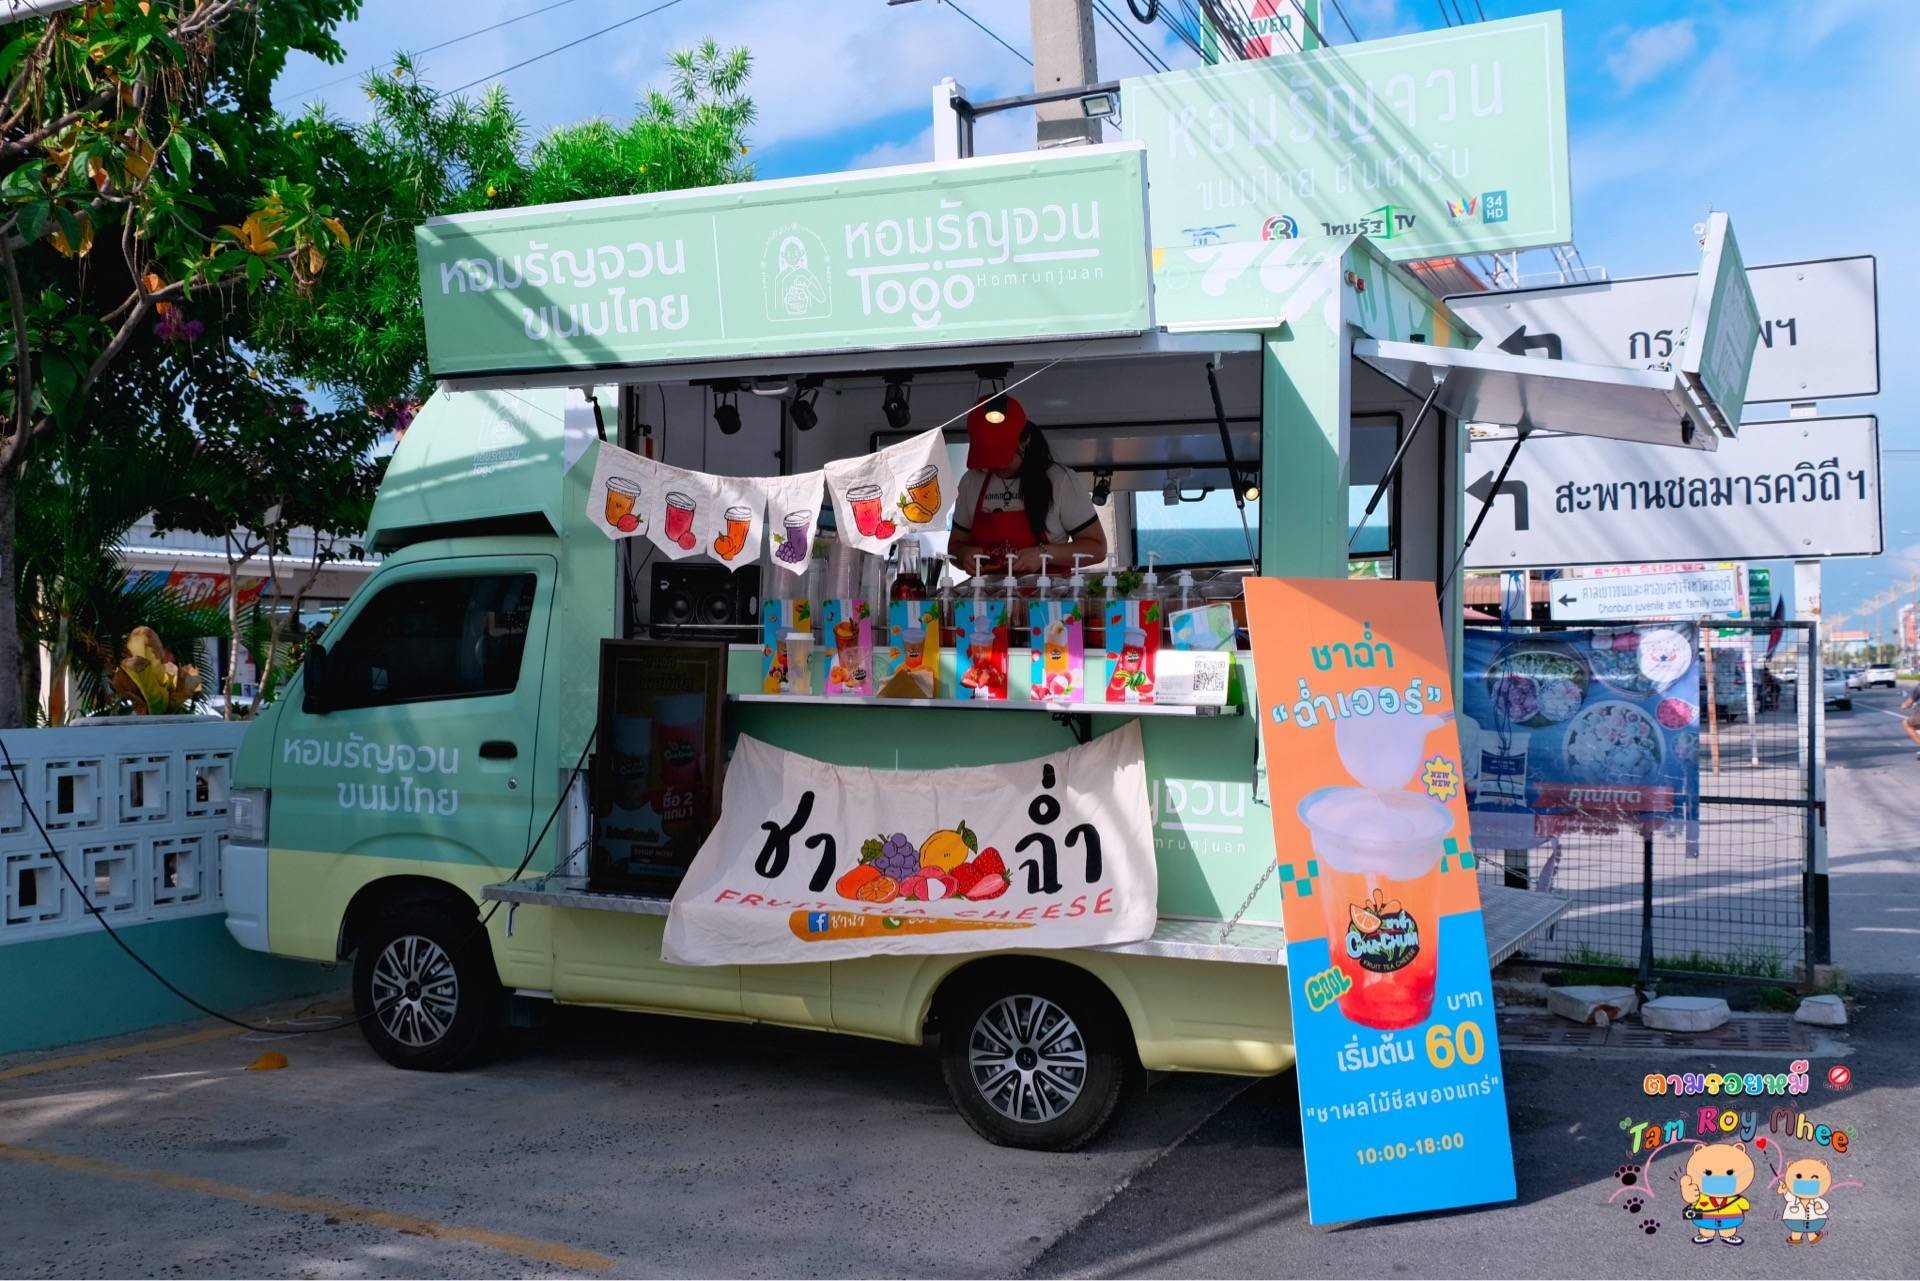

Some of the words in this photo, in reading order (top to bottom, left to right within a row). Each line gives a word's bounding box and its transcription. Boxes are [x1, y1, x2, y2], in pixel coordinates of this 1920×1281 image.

[1168, 60, 1503, 159] หอมรัญจวน
[1198, 166, 1315, 211] ขนมไทย
[1335, 143, 1470, 195] ต้นตำรับ
[845, 198, 1101, 265] หอมรัญจวน
[440, 238, 686, 293] หอมรัญจวน
[976, 265, 1104, 289] Homrunjuan
[524, 287, 689, 342] ขนมไทย
[1555, 456, 1866, 514] สะพานชลมารควิถีฯ
[1667, 599, 1681, 609] and
[1311, 621, 1394, 671] ชาฉ่ำ
[283, 733, 459, 774] หอมรัญจวน
[1430, 770, 1450, 780] NEW
[1431, 778, 1451, 789] NEW
[338, 776, 459, 817] ขนมไทย
[1309, 968, 1350, 1008] COOL
[1448, 990, 1483, 1011] บาท
[1337, 1033, 1414, 1073] เริ่มต้น
[1426, 1021, 1484, 1068] 60
[1357, 1132, 1464, 1165] 10:00-18:00
